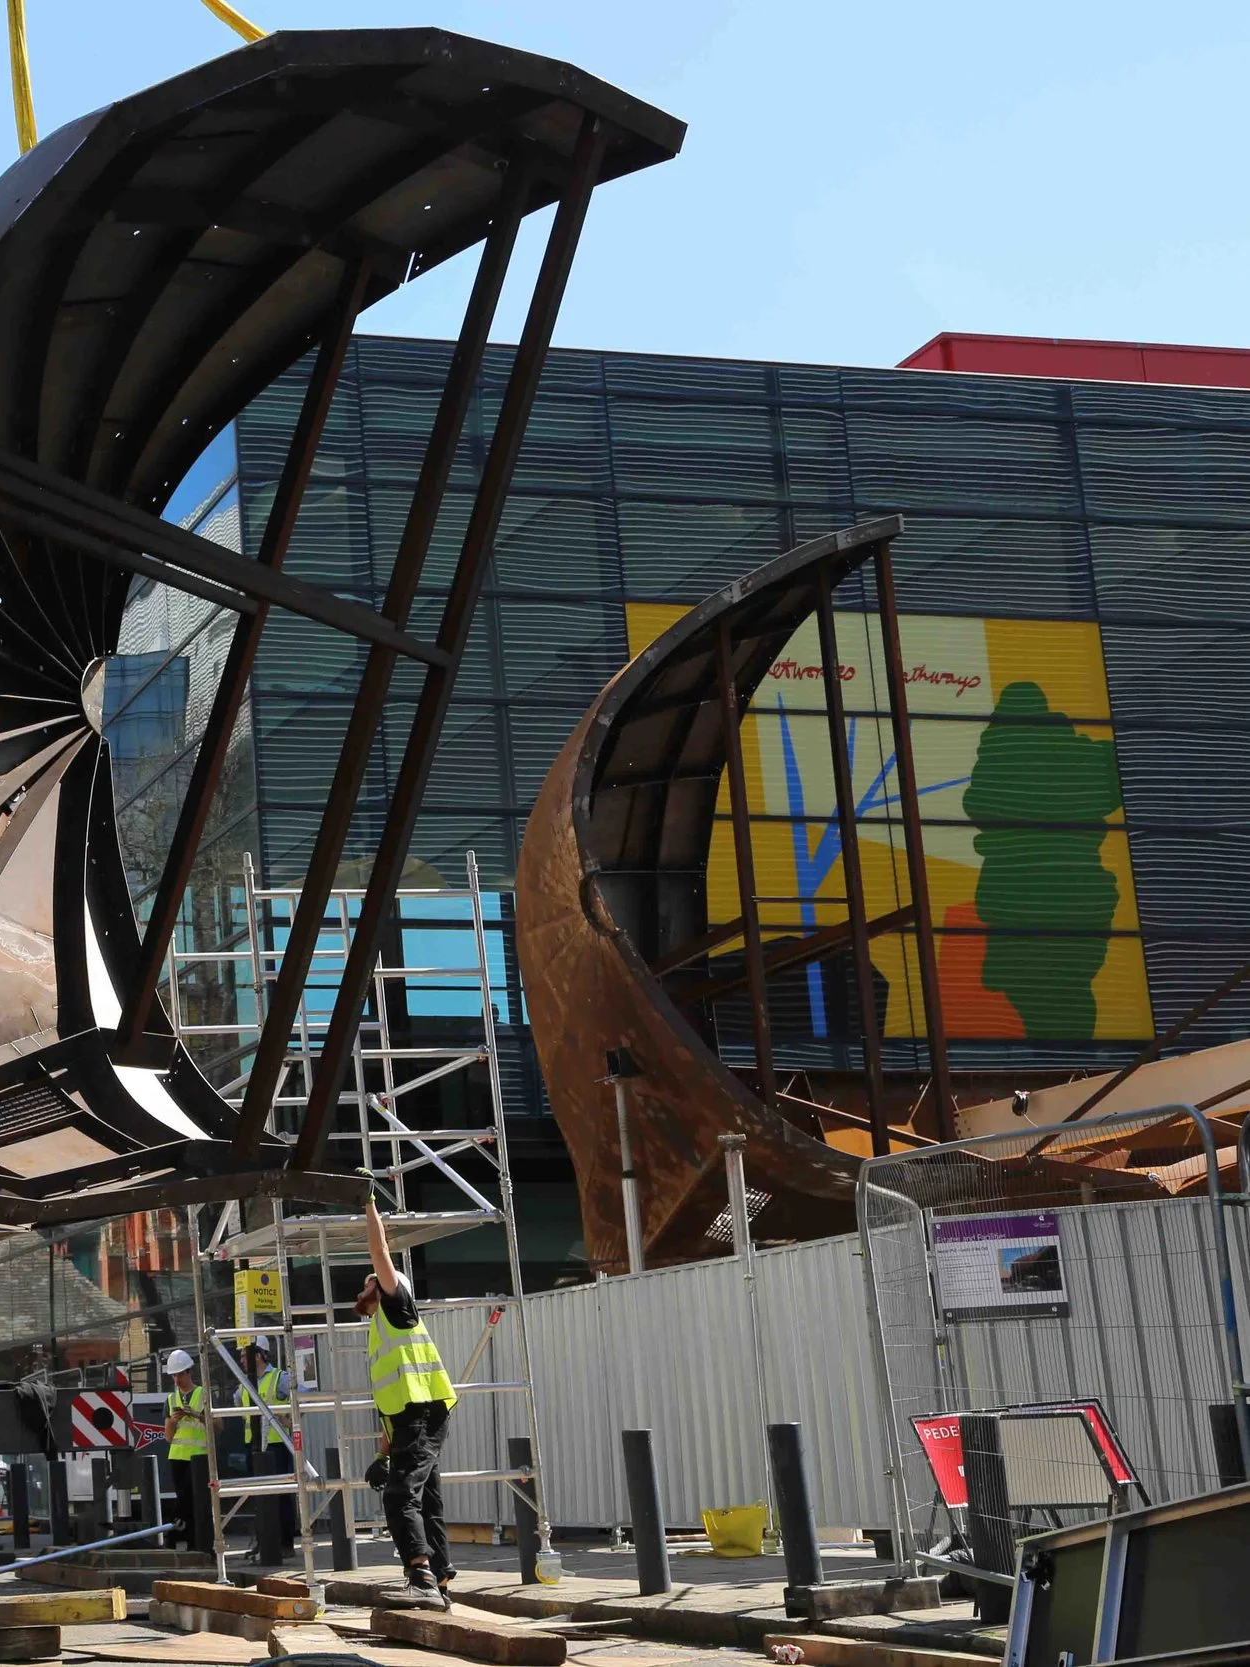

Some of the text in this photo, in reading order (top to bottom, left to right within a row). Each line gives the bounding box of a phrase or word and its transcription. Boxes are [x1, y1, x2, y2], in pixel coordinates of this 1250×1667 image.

[766, 657, 856, 681] etwors
[253, 1287, 277, 1297] NOTICE
[144, 1429, 166, 1441] Spe
[923, 1425, 960, 1440] PEDE
